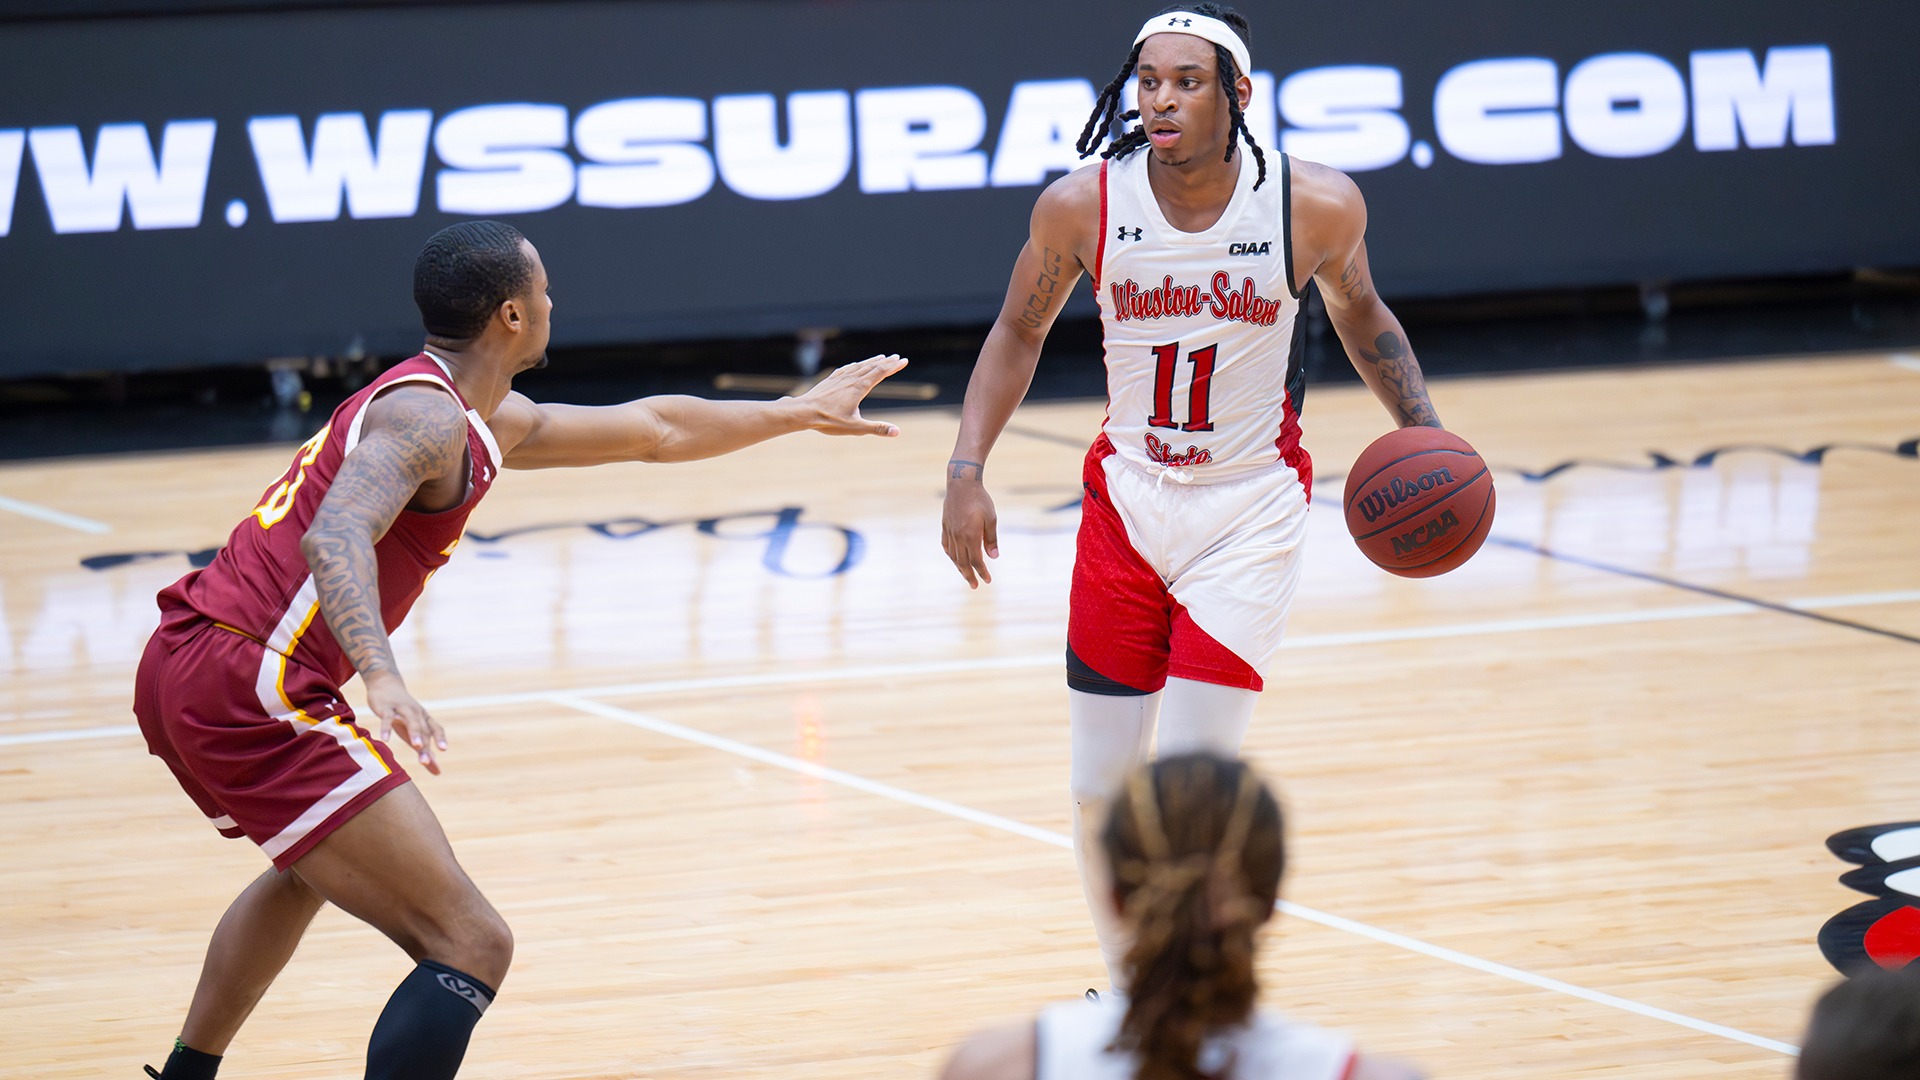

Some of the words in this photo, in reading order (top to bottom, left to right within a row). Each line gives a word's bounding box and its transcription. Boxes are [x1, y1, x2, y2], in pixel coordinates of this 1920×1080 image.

[0, 45, 1838, 236] W.WSSURAS.COM
[1228, 241, 1271, 257] CIAA
[1110, 270, 1283, 328] Winston-Salem
[1147, 341, 1219, 433] 11
[1357, 466, 1455, 523] Wilson
[1390, 508, 1460, 557] NCAA
